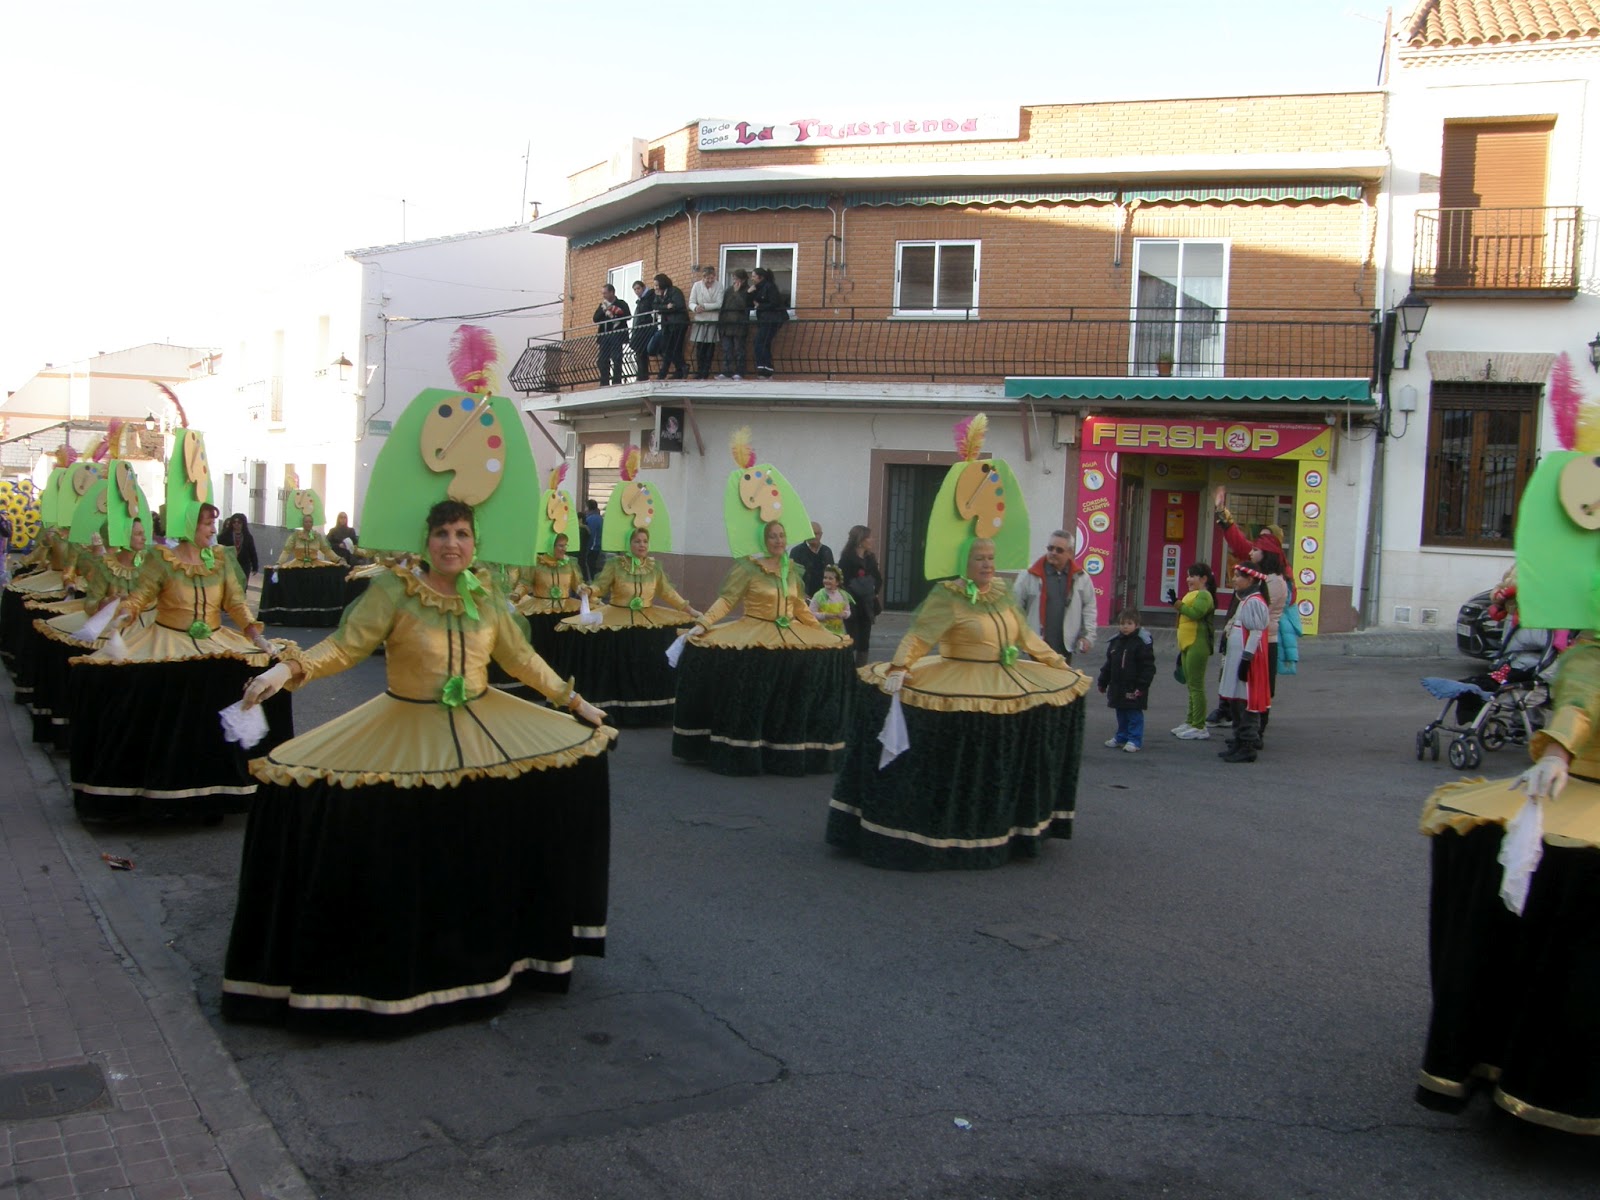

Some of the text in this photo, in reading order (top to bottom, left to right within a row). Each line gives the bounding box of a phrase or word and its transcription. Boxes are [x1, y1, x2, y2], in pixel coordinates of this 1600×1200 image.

[701, 126, 717, 135] Bar
[735, 121, 775, 145] La
[700, 134, 729, 146] Copas
[1092, 423, 1279, 453] FERSHOP
[1229, 432, 1246, 444] 24
